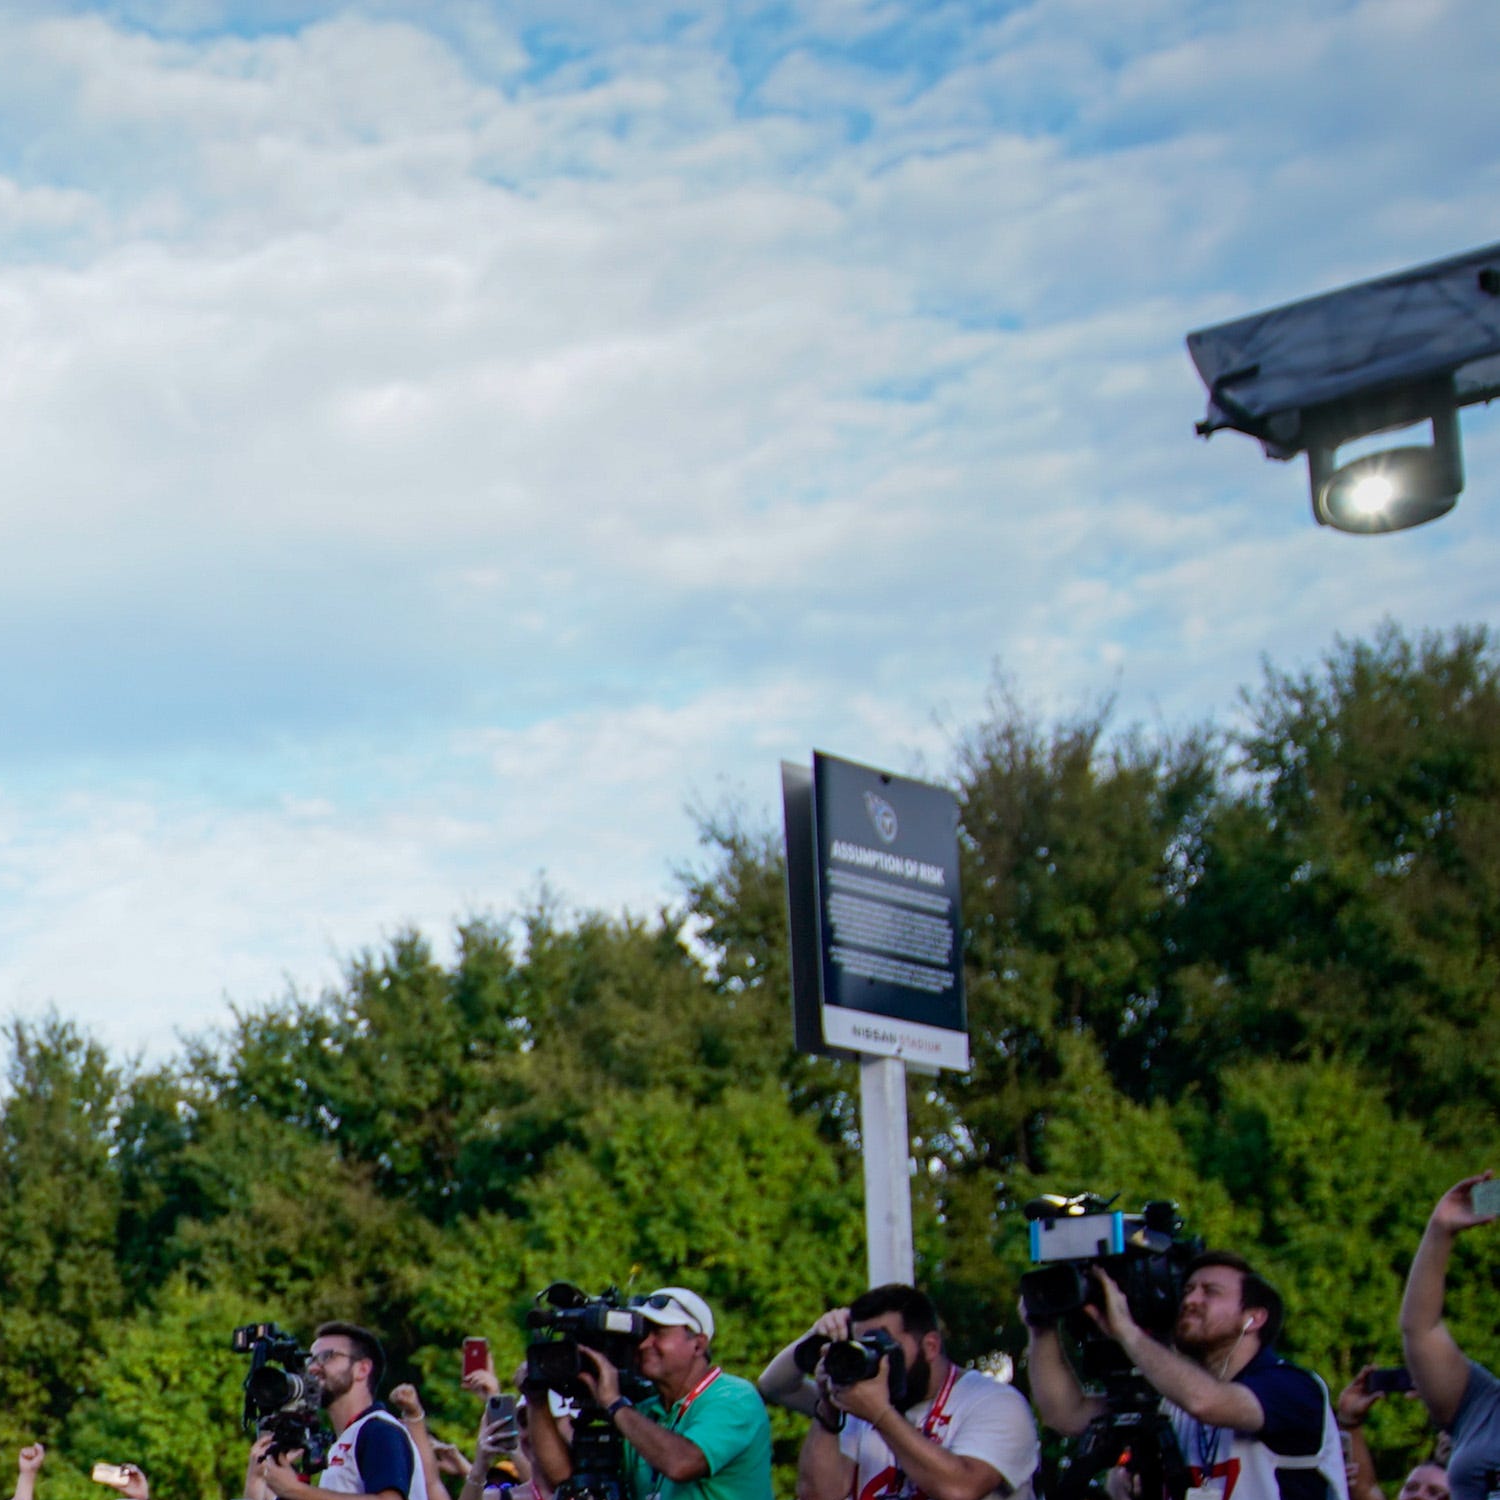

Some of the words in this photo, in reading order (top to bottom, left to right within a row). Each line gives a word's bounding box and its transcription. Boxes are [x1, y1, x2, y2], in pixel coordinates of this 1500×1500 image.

[830, 840, 904, 877] ASSUMPTION
[905, 858, 919, 880] OF
[919, 862, 946, 888] RISK
[851, 1024, 898, 1045] NISSAN
